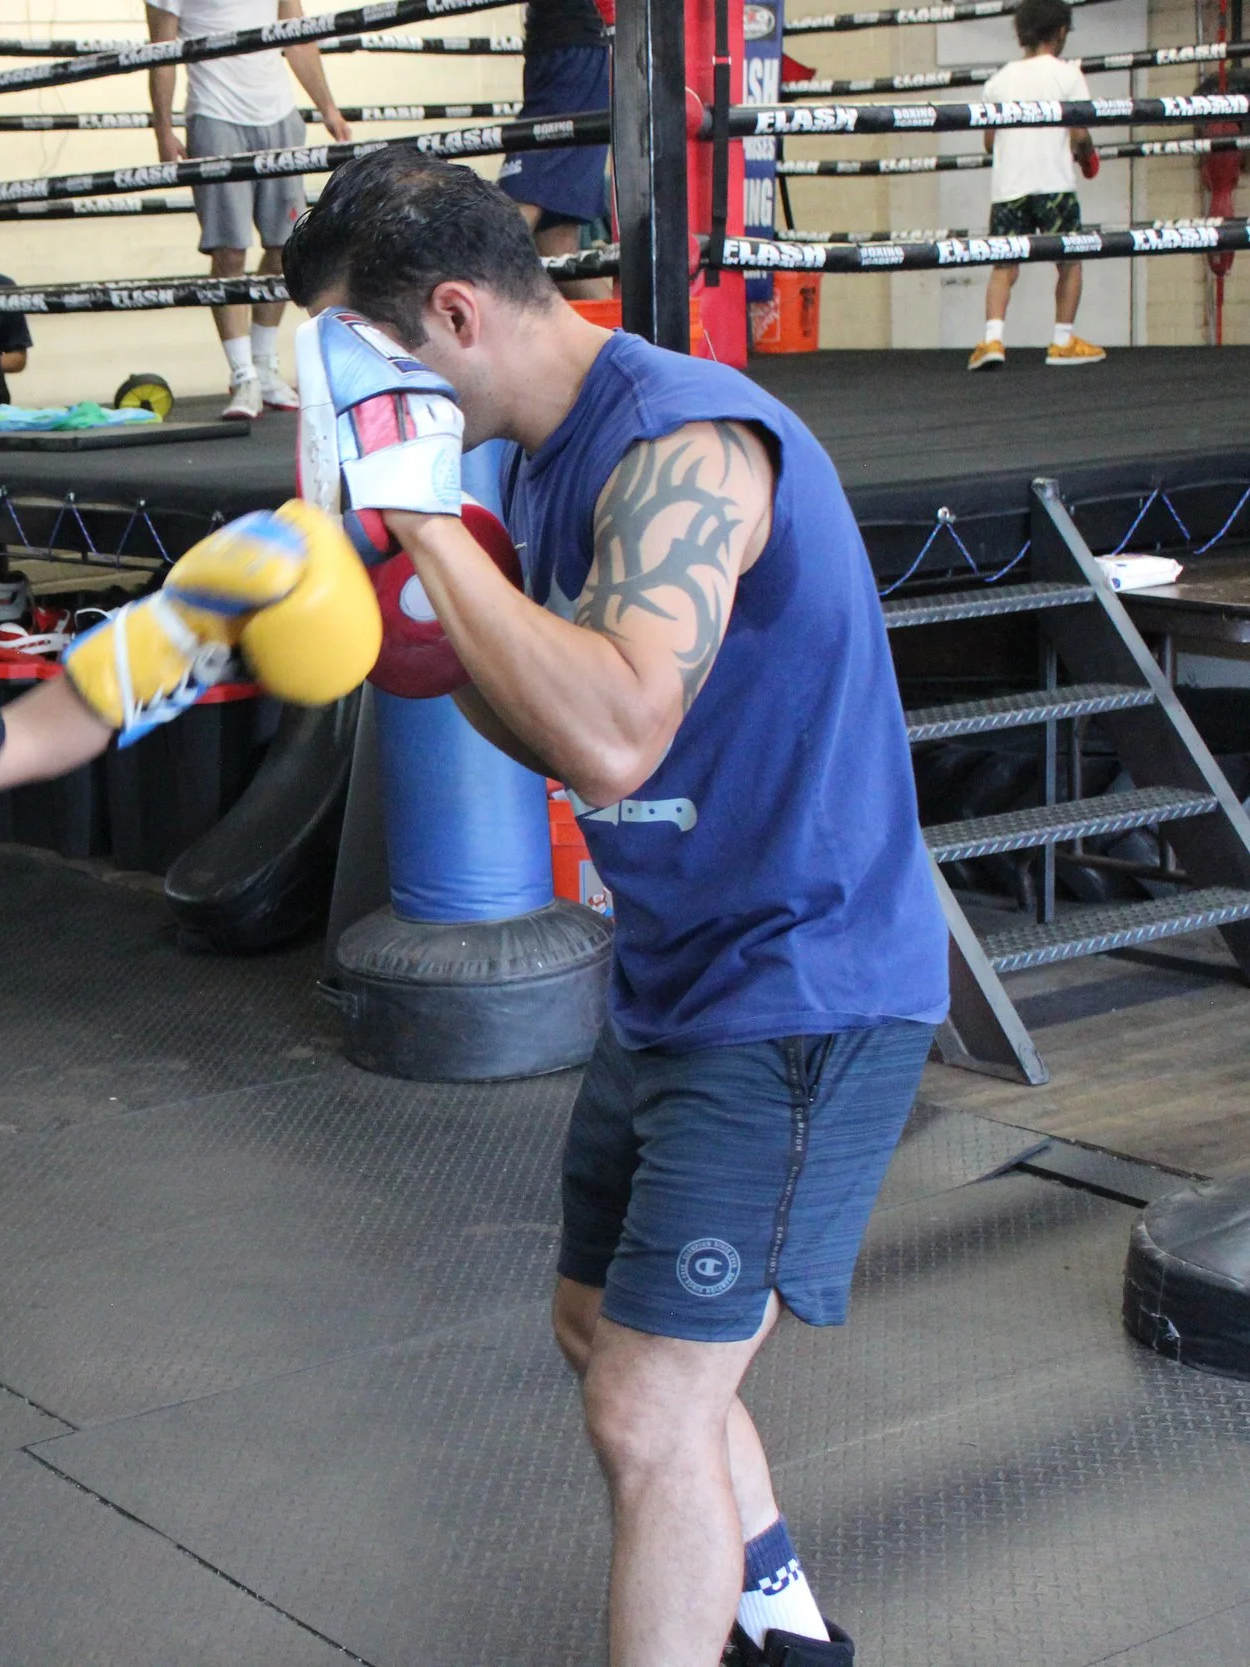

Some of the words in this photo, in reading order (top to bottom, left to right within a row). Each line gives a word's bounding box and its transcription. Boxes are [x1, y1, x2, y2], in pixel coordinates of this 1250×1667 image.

[968, 100, 1063, 121] FLASH
[1160, 94, 1249, 113] FLASH
[754, 108, 858, 134] FLASH
[417, 126, 503, 154] FLASH
[1141, 138, 1212, 155] FLASH
[254, 146, 329, 174] FLASH
[113, 163, 179, 189] FLASH
[1130, 226, 1220, 245] FLASH
[723, 239, 827, 262] FLASH
[860, 246, 905, 258] BOXING
[936, 236, 1031, 258] FLASH
[111, 289, 174, 308] FLASH
